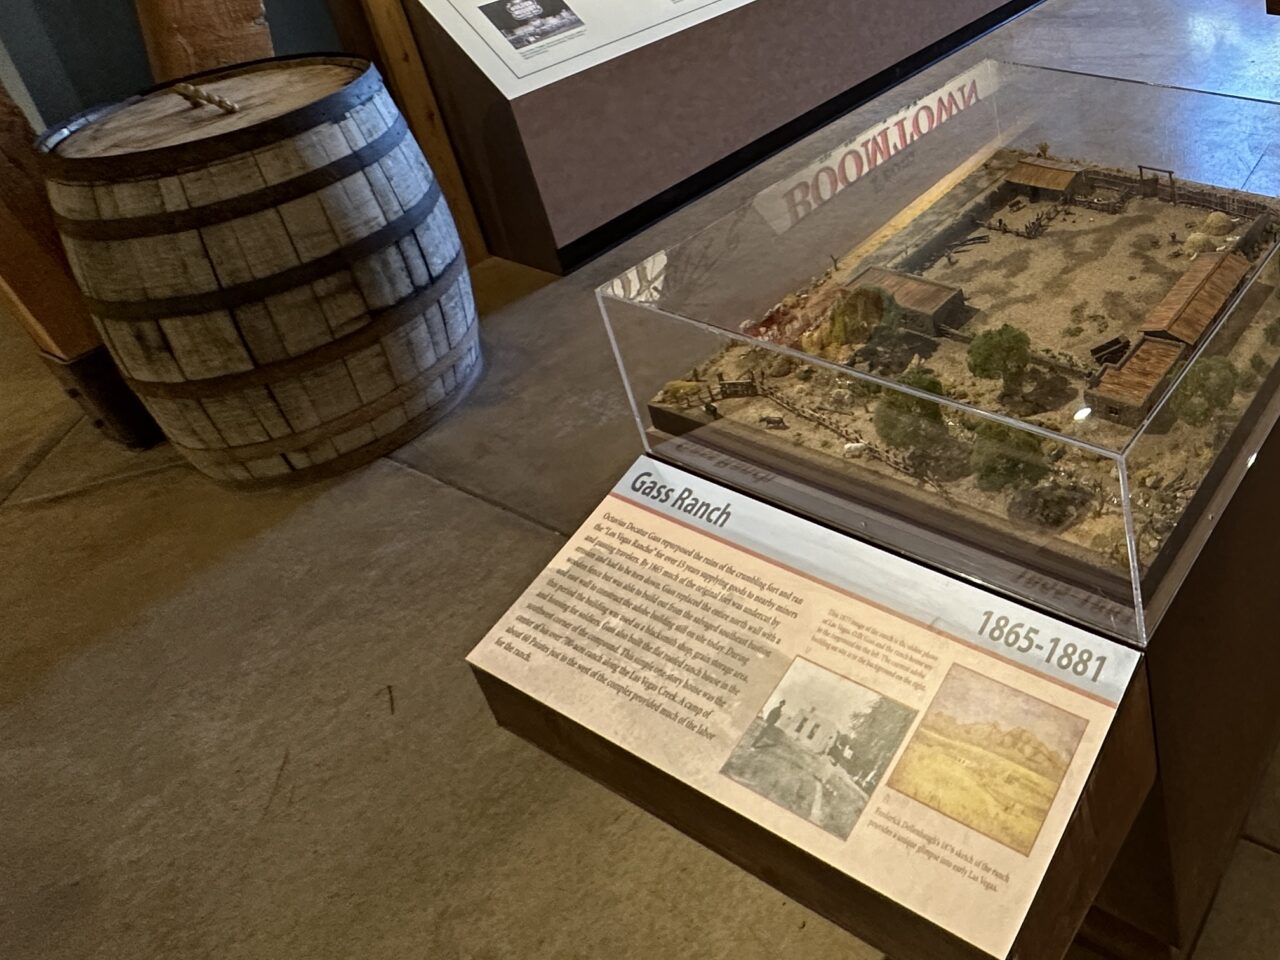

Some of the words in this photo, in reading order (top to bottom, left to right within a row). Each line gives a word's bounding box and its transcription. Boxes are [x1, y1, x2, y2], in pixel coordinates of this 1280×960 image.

[630, 470, 671, 507] Gass
[672, 486, 731, 529] Ranch
[976, 608, 1108, 685] 1865-1881
